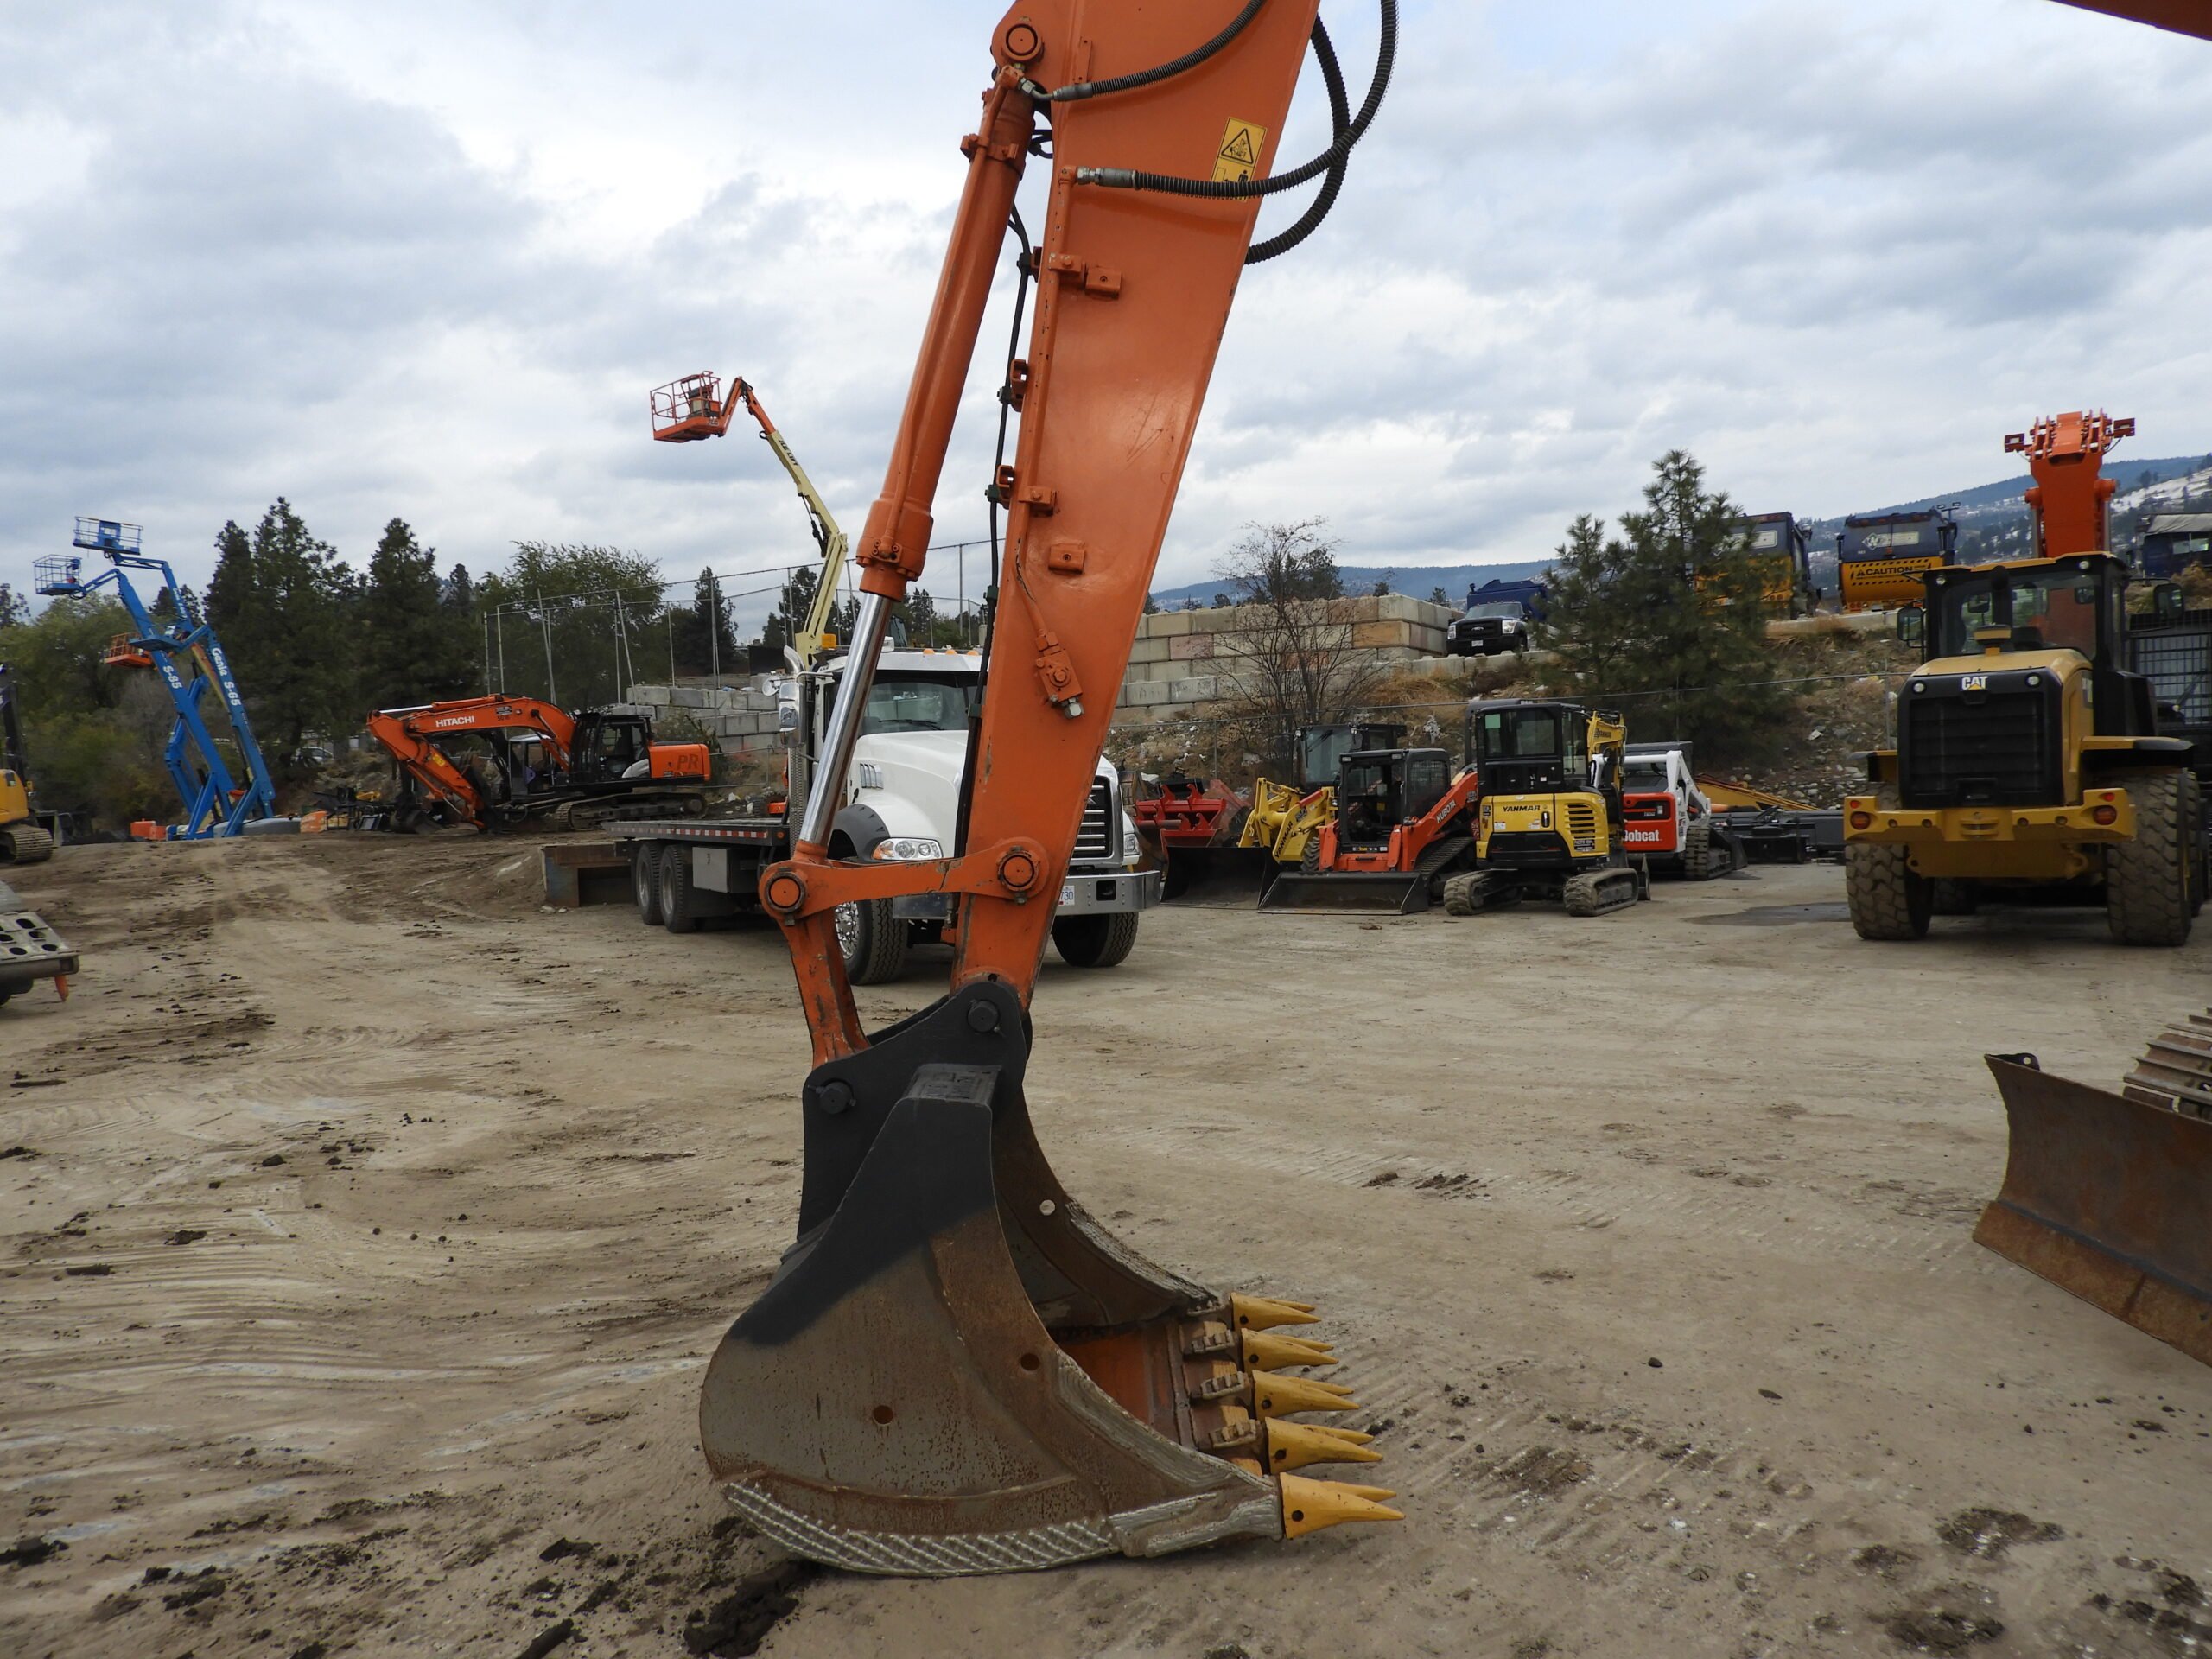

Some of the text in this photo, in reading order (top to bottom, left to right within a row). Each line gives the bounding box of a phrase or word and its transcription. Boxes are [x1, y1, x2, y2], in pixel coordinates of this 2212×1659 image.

[779, 439, 789, 451] JLG
[1866, 566, 1913, 575] CAUTION
[162, 665, 182, 690] S-85
[212, 647, 242, 706] Genie S-65
[1961, 676, 1989, 690] CAT
[435, 715, 475, 728] HITACHI
[1436, 799, 1457, 823] KUBOTA
[1503, 804, 1541, 813] YANMAR
[1274, 821, 1294, 858] YANMAR
